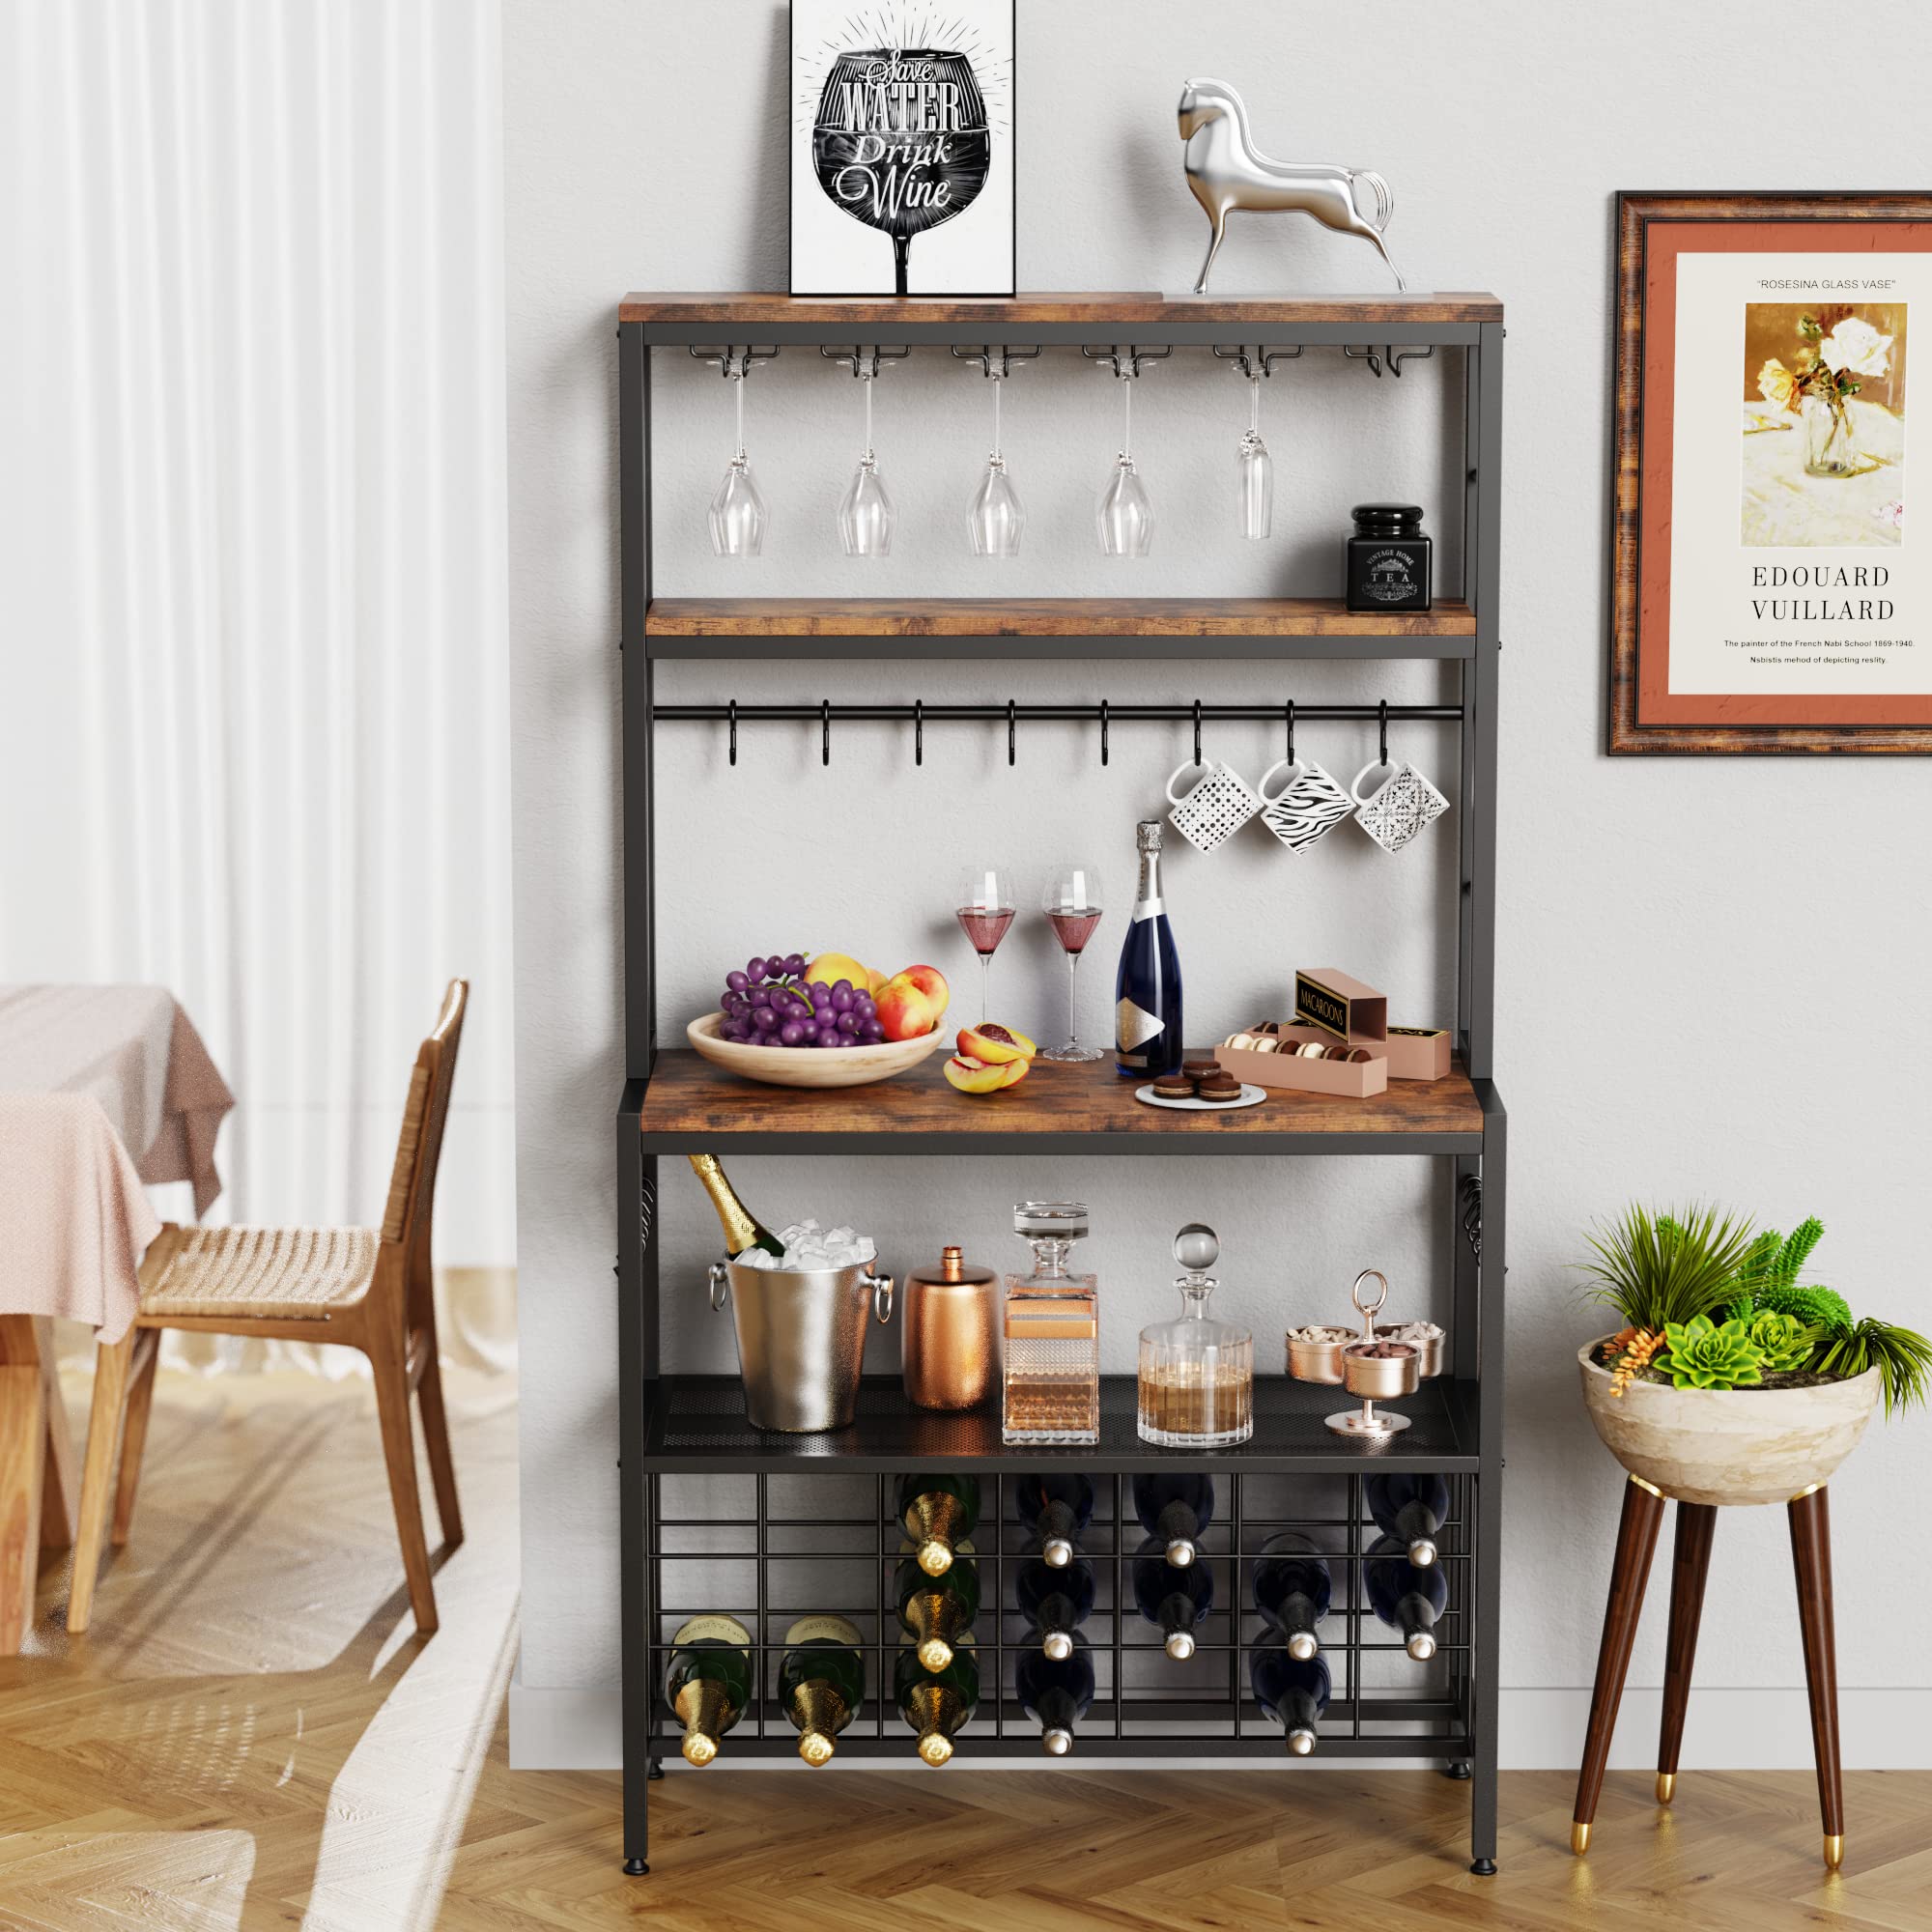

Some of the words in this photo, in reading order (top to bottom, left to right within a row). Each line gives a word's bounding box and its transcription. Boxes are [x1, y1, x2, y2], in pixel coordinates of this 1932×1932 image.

[858, 49, 934, 89] Save
[841, 82, 960, 131] WATER
[852, 135, 952, 163] Drink
[836, 162, 952, 219] Wine
[1821, 279, 1860, 289] GLASS
[1366, 549, 1394, 565] VINTAGE
[1395, 550, 1415, 566] HOME
[1751, 566, 1889, 587] EDOUARD
[1750, 600, 1894, 620] VUILLARD
[1741, 639, 1769, 648] painter
[1823, 656, 1860, 665] depicting
[1300, 988, 1344, 1027] MACAROONS
